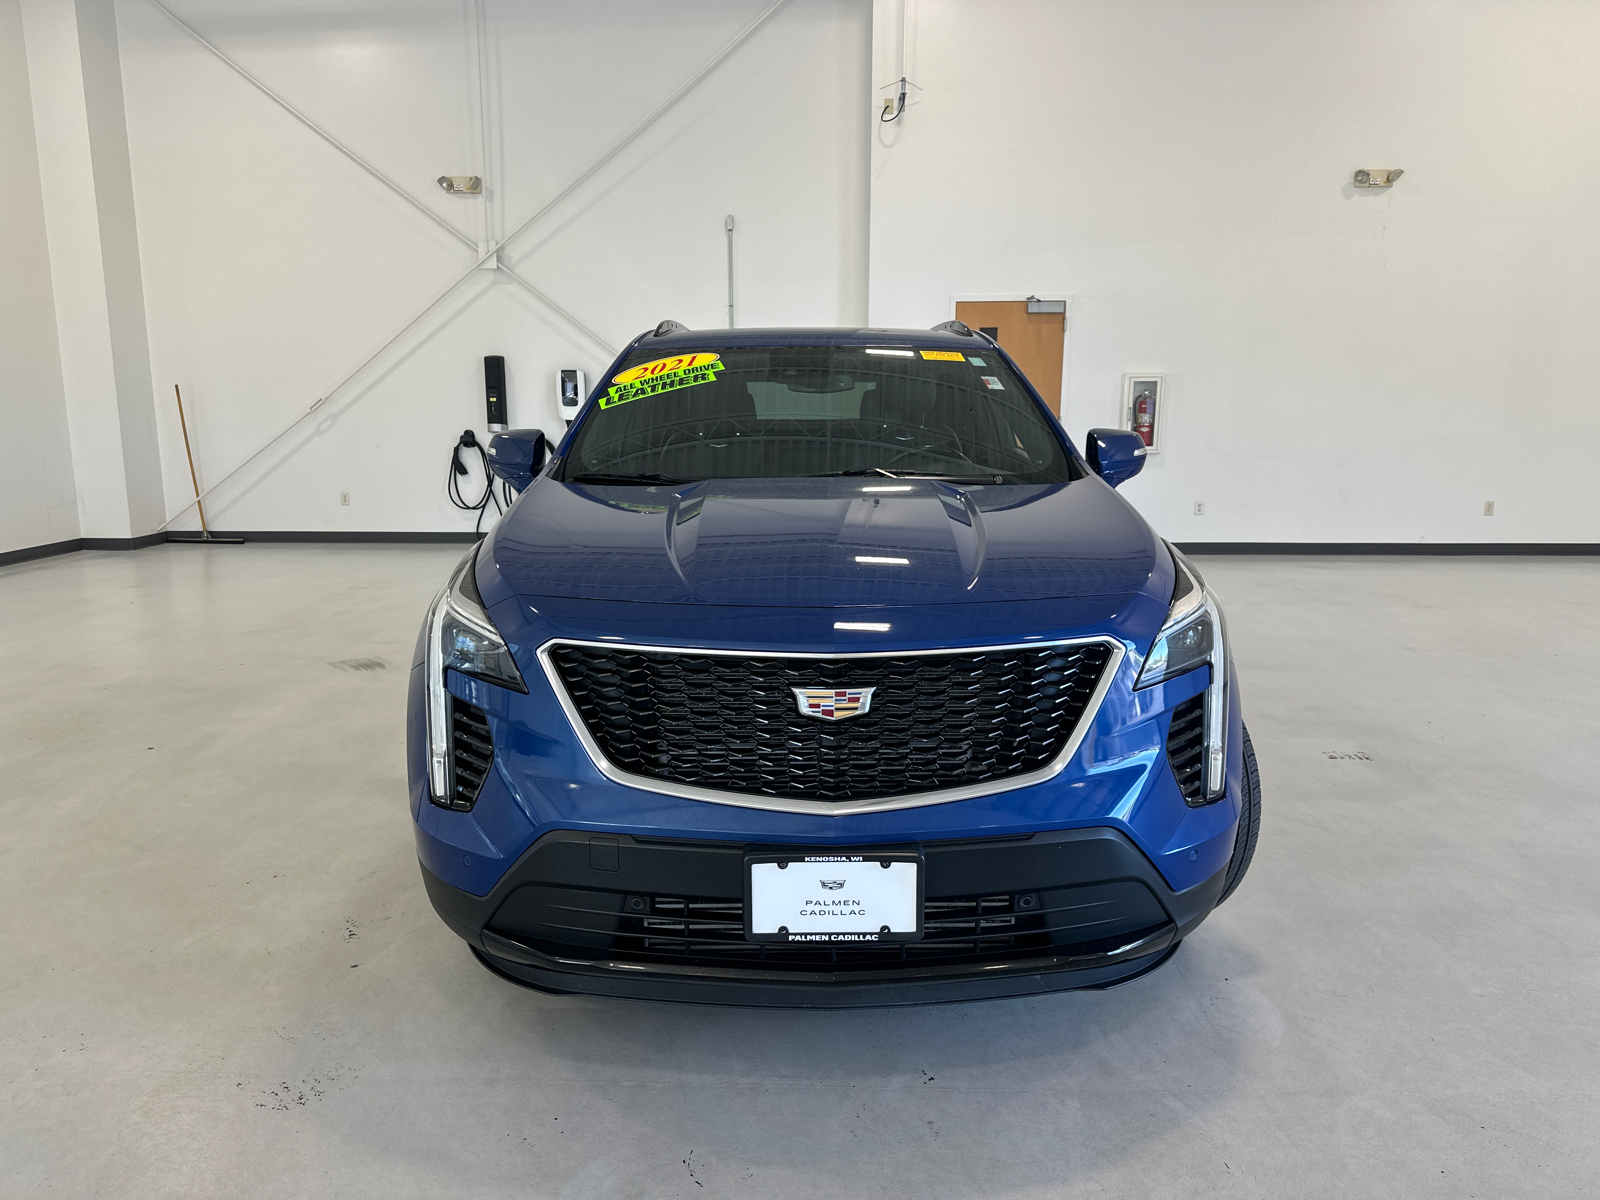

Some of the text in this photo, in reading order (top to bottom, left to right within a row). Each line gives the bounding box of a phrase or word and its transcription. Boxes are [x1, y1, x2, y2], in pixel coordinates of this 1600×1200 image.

[614, 362, 720, 394] ALL WHEEL DRIVE
[632, 355, 698, 380] 2021
[604, 372, 710, 407] LEATHER
